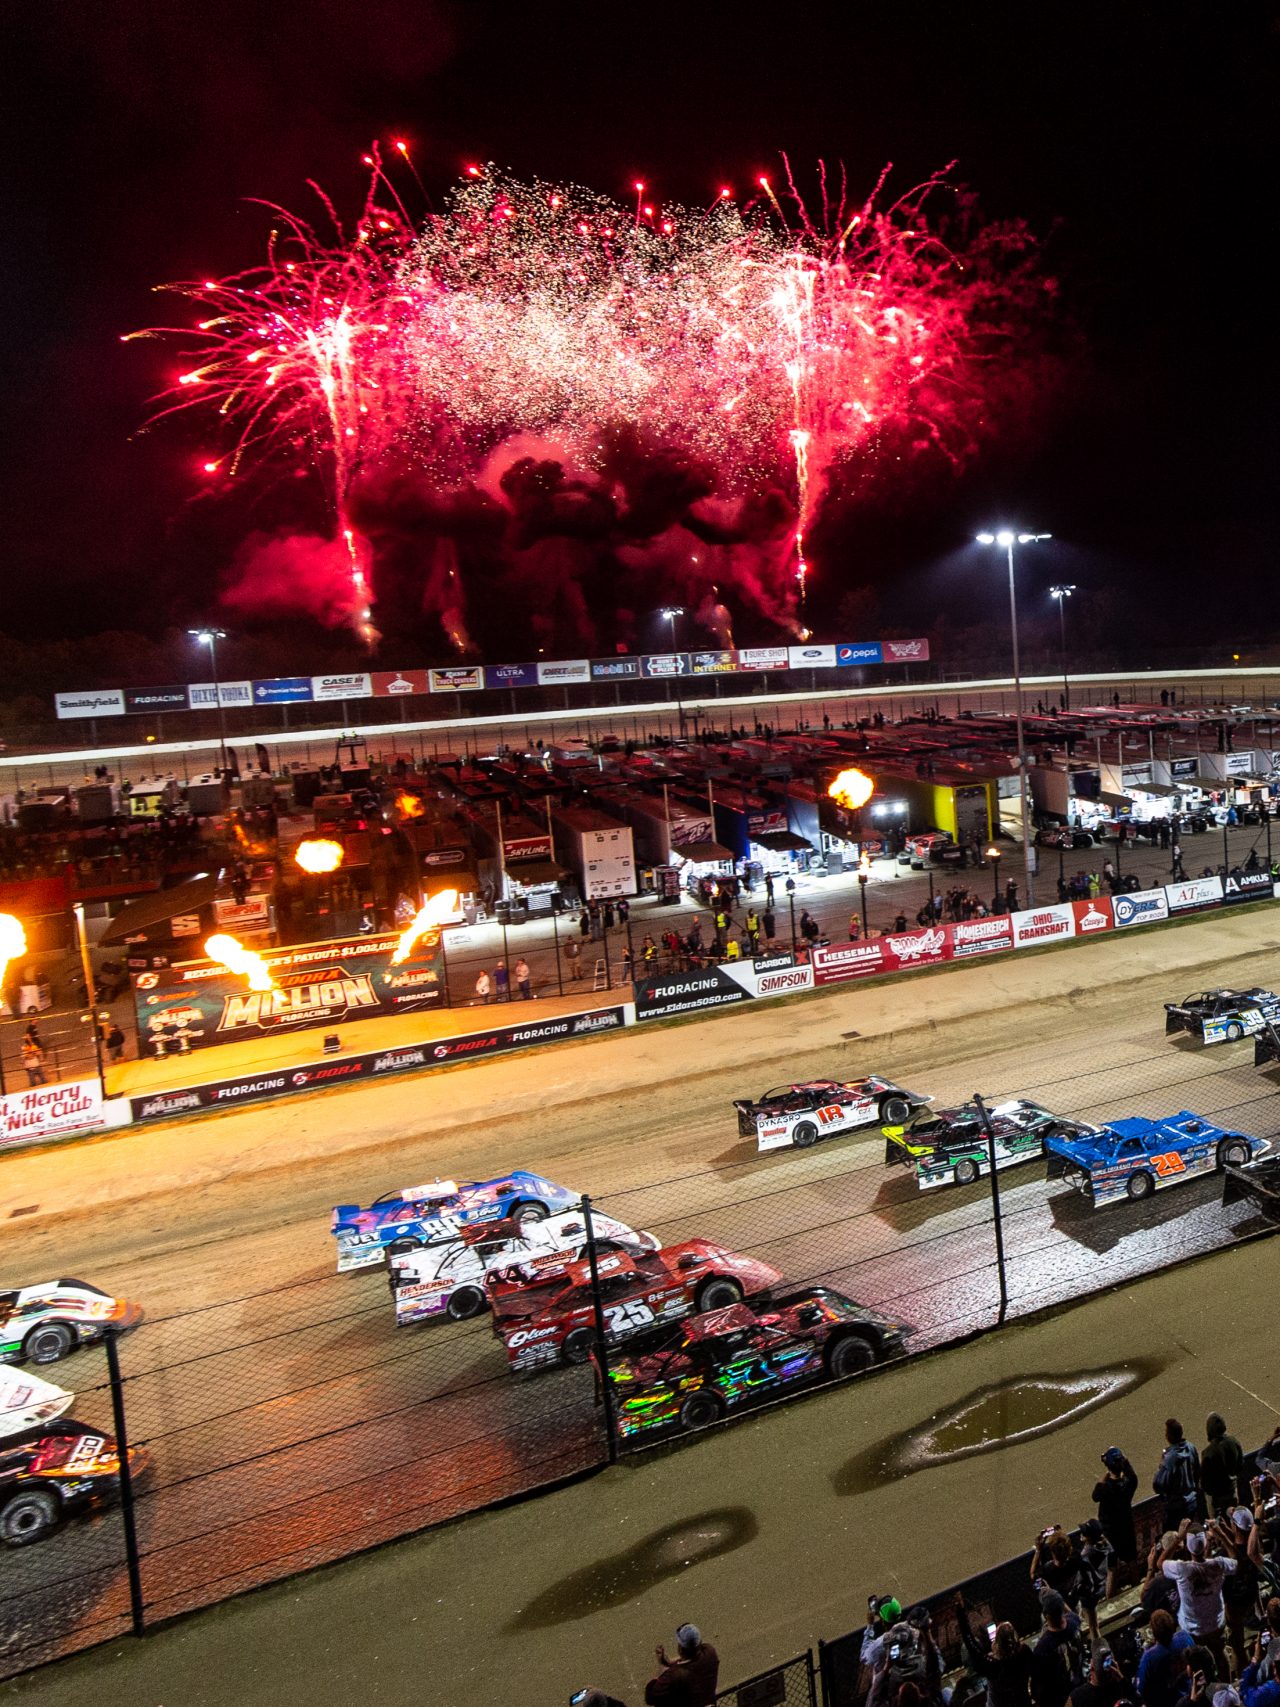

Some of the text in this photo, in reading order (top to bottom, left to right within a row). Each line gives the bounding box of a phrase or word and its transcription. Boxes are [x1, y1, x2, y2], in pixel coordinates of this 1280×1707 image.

[749, 648, 786, 658] SURE SHOT
[853, 648, 878, 659] pepsi
[496, 669, 525, 677] ULTRA
[593, 664, 623, 676] Mobil
[694, 664, 737, 673] INTERNET
[322, 677, 353, 686] CASE
[59, 698, 121, 709] Smithfield
[135, 694, 185, 704] FLORACING
[1240, 873, 1269, 886] AMKUS
[1177, 887, 1198, 902] AT
[1032, 912, 1053, 926] OHIO
[1083, 917, 1105, 927] Casey's
[956, 918, 1009, 939] HOMESTRETCH
[1019, 922, 1069, 941] CRANKSHAFT
[293, 949, 340, 963] PAYOUT:
[754, 950, 809, 970] CARBON X
[813, 945, 881, 968] CHEESEMAN
[279, 970, 340, 987] LDORA
[761, 971, 808, 992] SIMPSON
[655, 977, 719, 998] FLORACING
[223, 976, 375, 1028] MILLION
[398, 991, 439, 1003] FLORACING
[638, 991, 742, 1018] www.Eldora5050.com
[281, 1008, 331, 1023] FLORACING
[1241, 1009, 1263, 1026] 39
[512, 1023, 568, 1042] FLORACING
[218, 1077, 285, 1099] FLORACING
[21, 1085, 81, 1111] Henry
[4, 1096, 92, 1132] Nite Club
[815, 1104, 845, 1126] 18
[400, 1277, 456, 1297] HENDERSON
[602, 1299, 655, 1333] 25
[518, 1341, 556, 1355] CAPITAL
